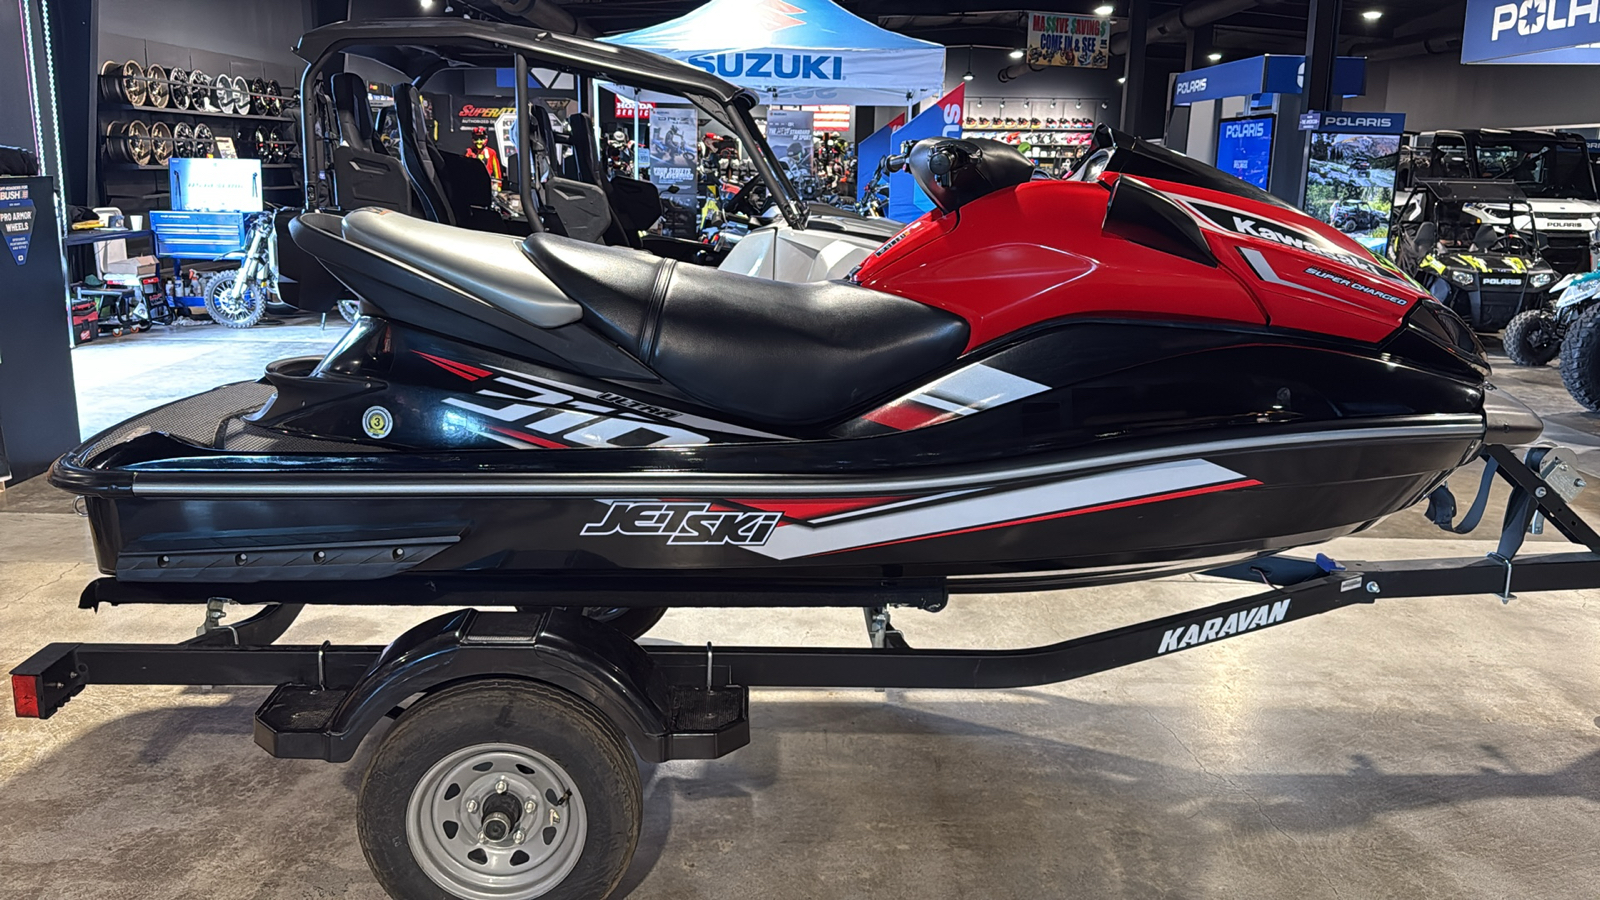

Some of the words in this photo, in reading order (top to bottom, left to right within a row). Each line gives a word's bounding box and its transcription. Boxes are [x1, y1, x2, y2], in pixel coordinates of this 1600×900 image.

[1491, 0, 1600, 41] POLA
[1040, 33, 1063, 51] COME
[1064, 35, 1073, 51] IN
[1074, 38, 1080, 52] &
[1082, 36, 1096, 53] SEE
[688, 53, 842, 80] SUZUKI
[1177, 78, 1207, 95] POLARIS
[1226, 123, 1264, 138] POLARIS
[1325, 117, 1391, 127] POLARIS
[6, 222, 29, 232] WHEELS
[1233, 216, 1383, 278] Kawasaki
[1305, 267, 1351, 287] SUPER
[1350, 282, 1408, 307] CHARGED
[1482, 278, 1522, 286] POLARIS
[373, 417, 381, 427] 3
[1157, 598, 1292, 654] KARAVAN
